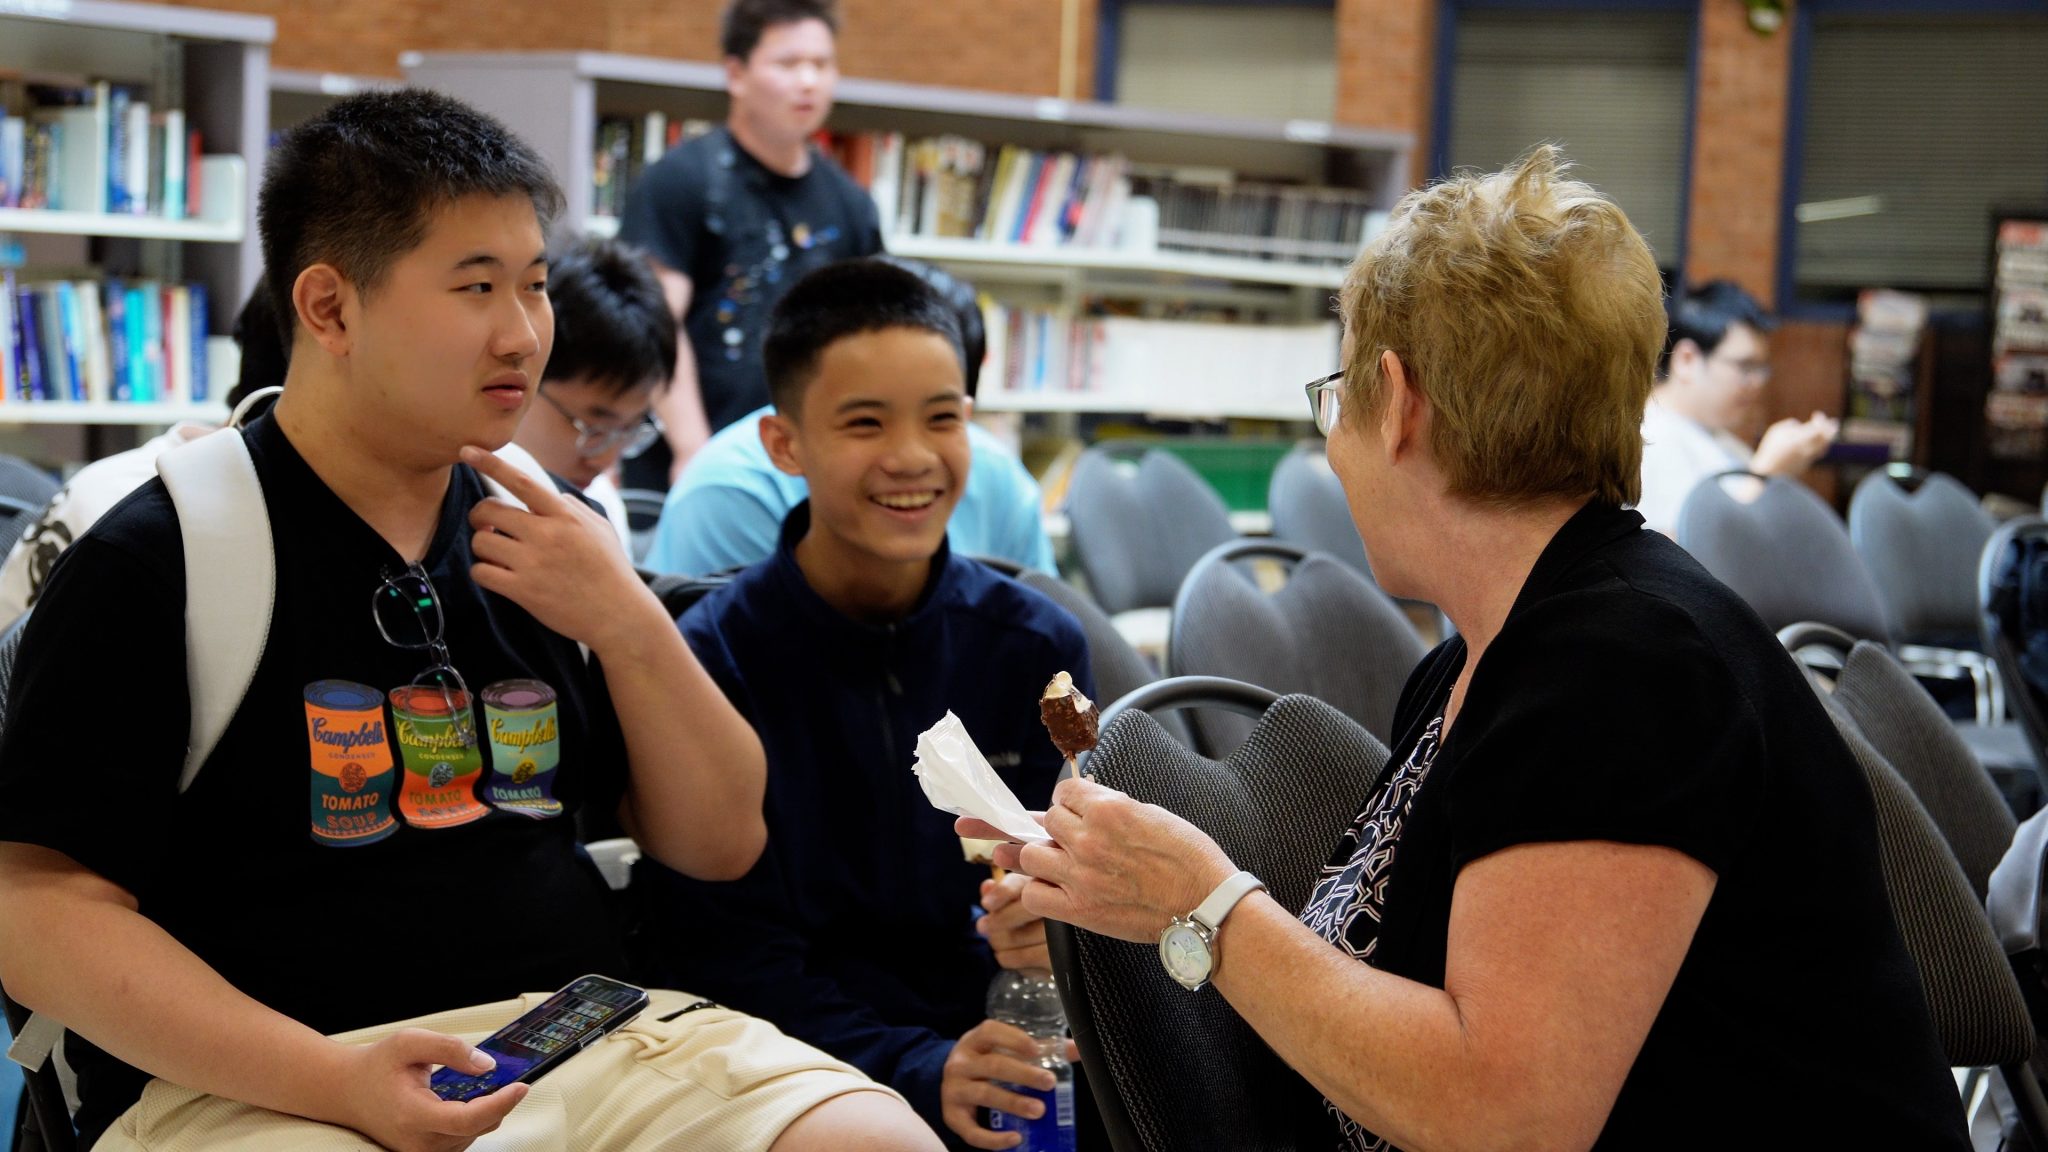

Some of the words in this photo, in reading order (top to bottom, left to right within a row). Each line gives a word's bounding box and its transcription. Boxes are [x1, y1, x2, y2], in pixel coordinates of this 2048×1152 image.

[408, 789, 462, 805] TOMATO
[492, 785, 541, 800] TOMATO
[322, 792, 379, 810] TOMATO
[326, 812, 377, 829] SOUP
